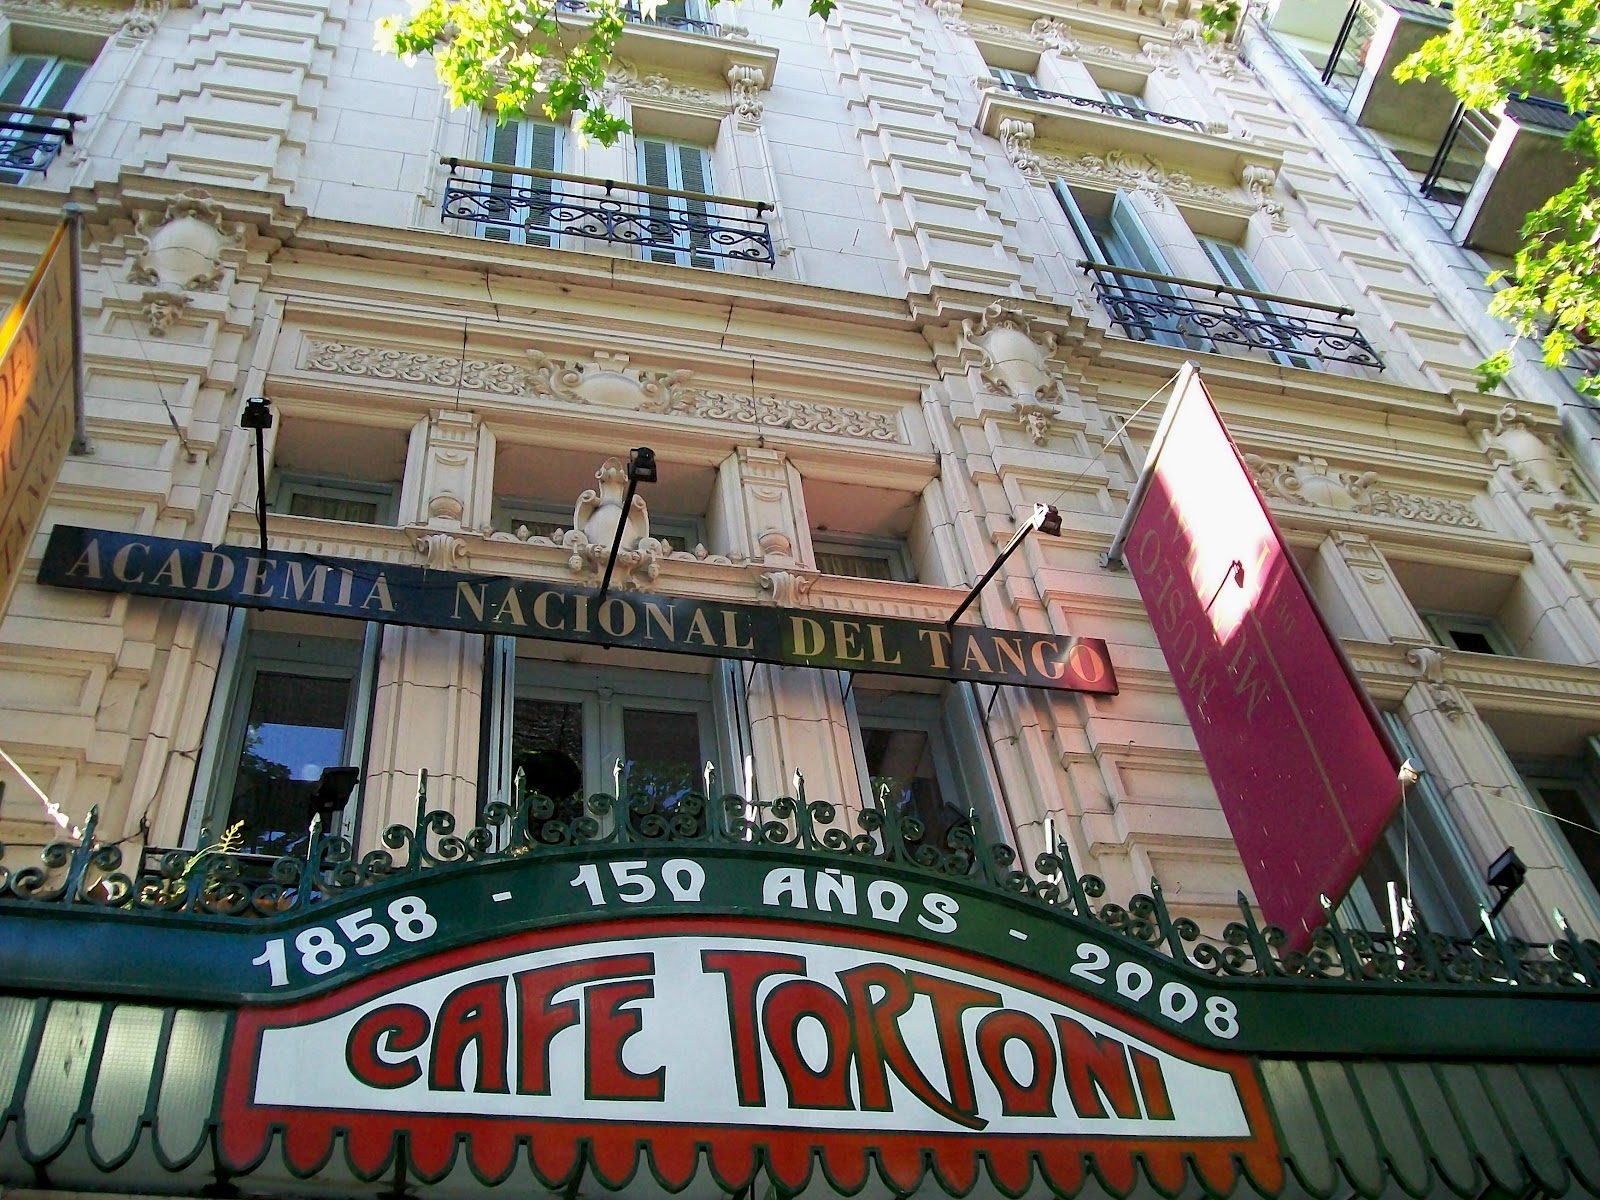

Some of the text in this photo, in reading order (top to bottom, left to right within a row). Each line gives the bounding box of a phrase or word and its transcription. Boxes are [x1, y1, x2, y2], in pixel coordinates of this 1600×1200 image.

[65, 536, 1106, 685] ACADEMIA NACIONAL DEL TANGO
[251, 895, 438, 987] 1858
[569, 858, 707, 906] 150
[762, 866, 960, 934] AÑOS
[1069, 942, 1240, 1040] 2008
[344, 949, 1176, 1132] CAFE TORTONI
